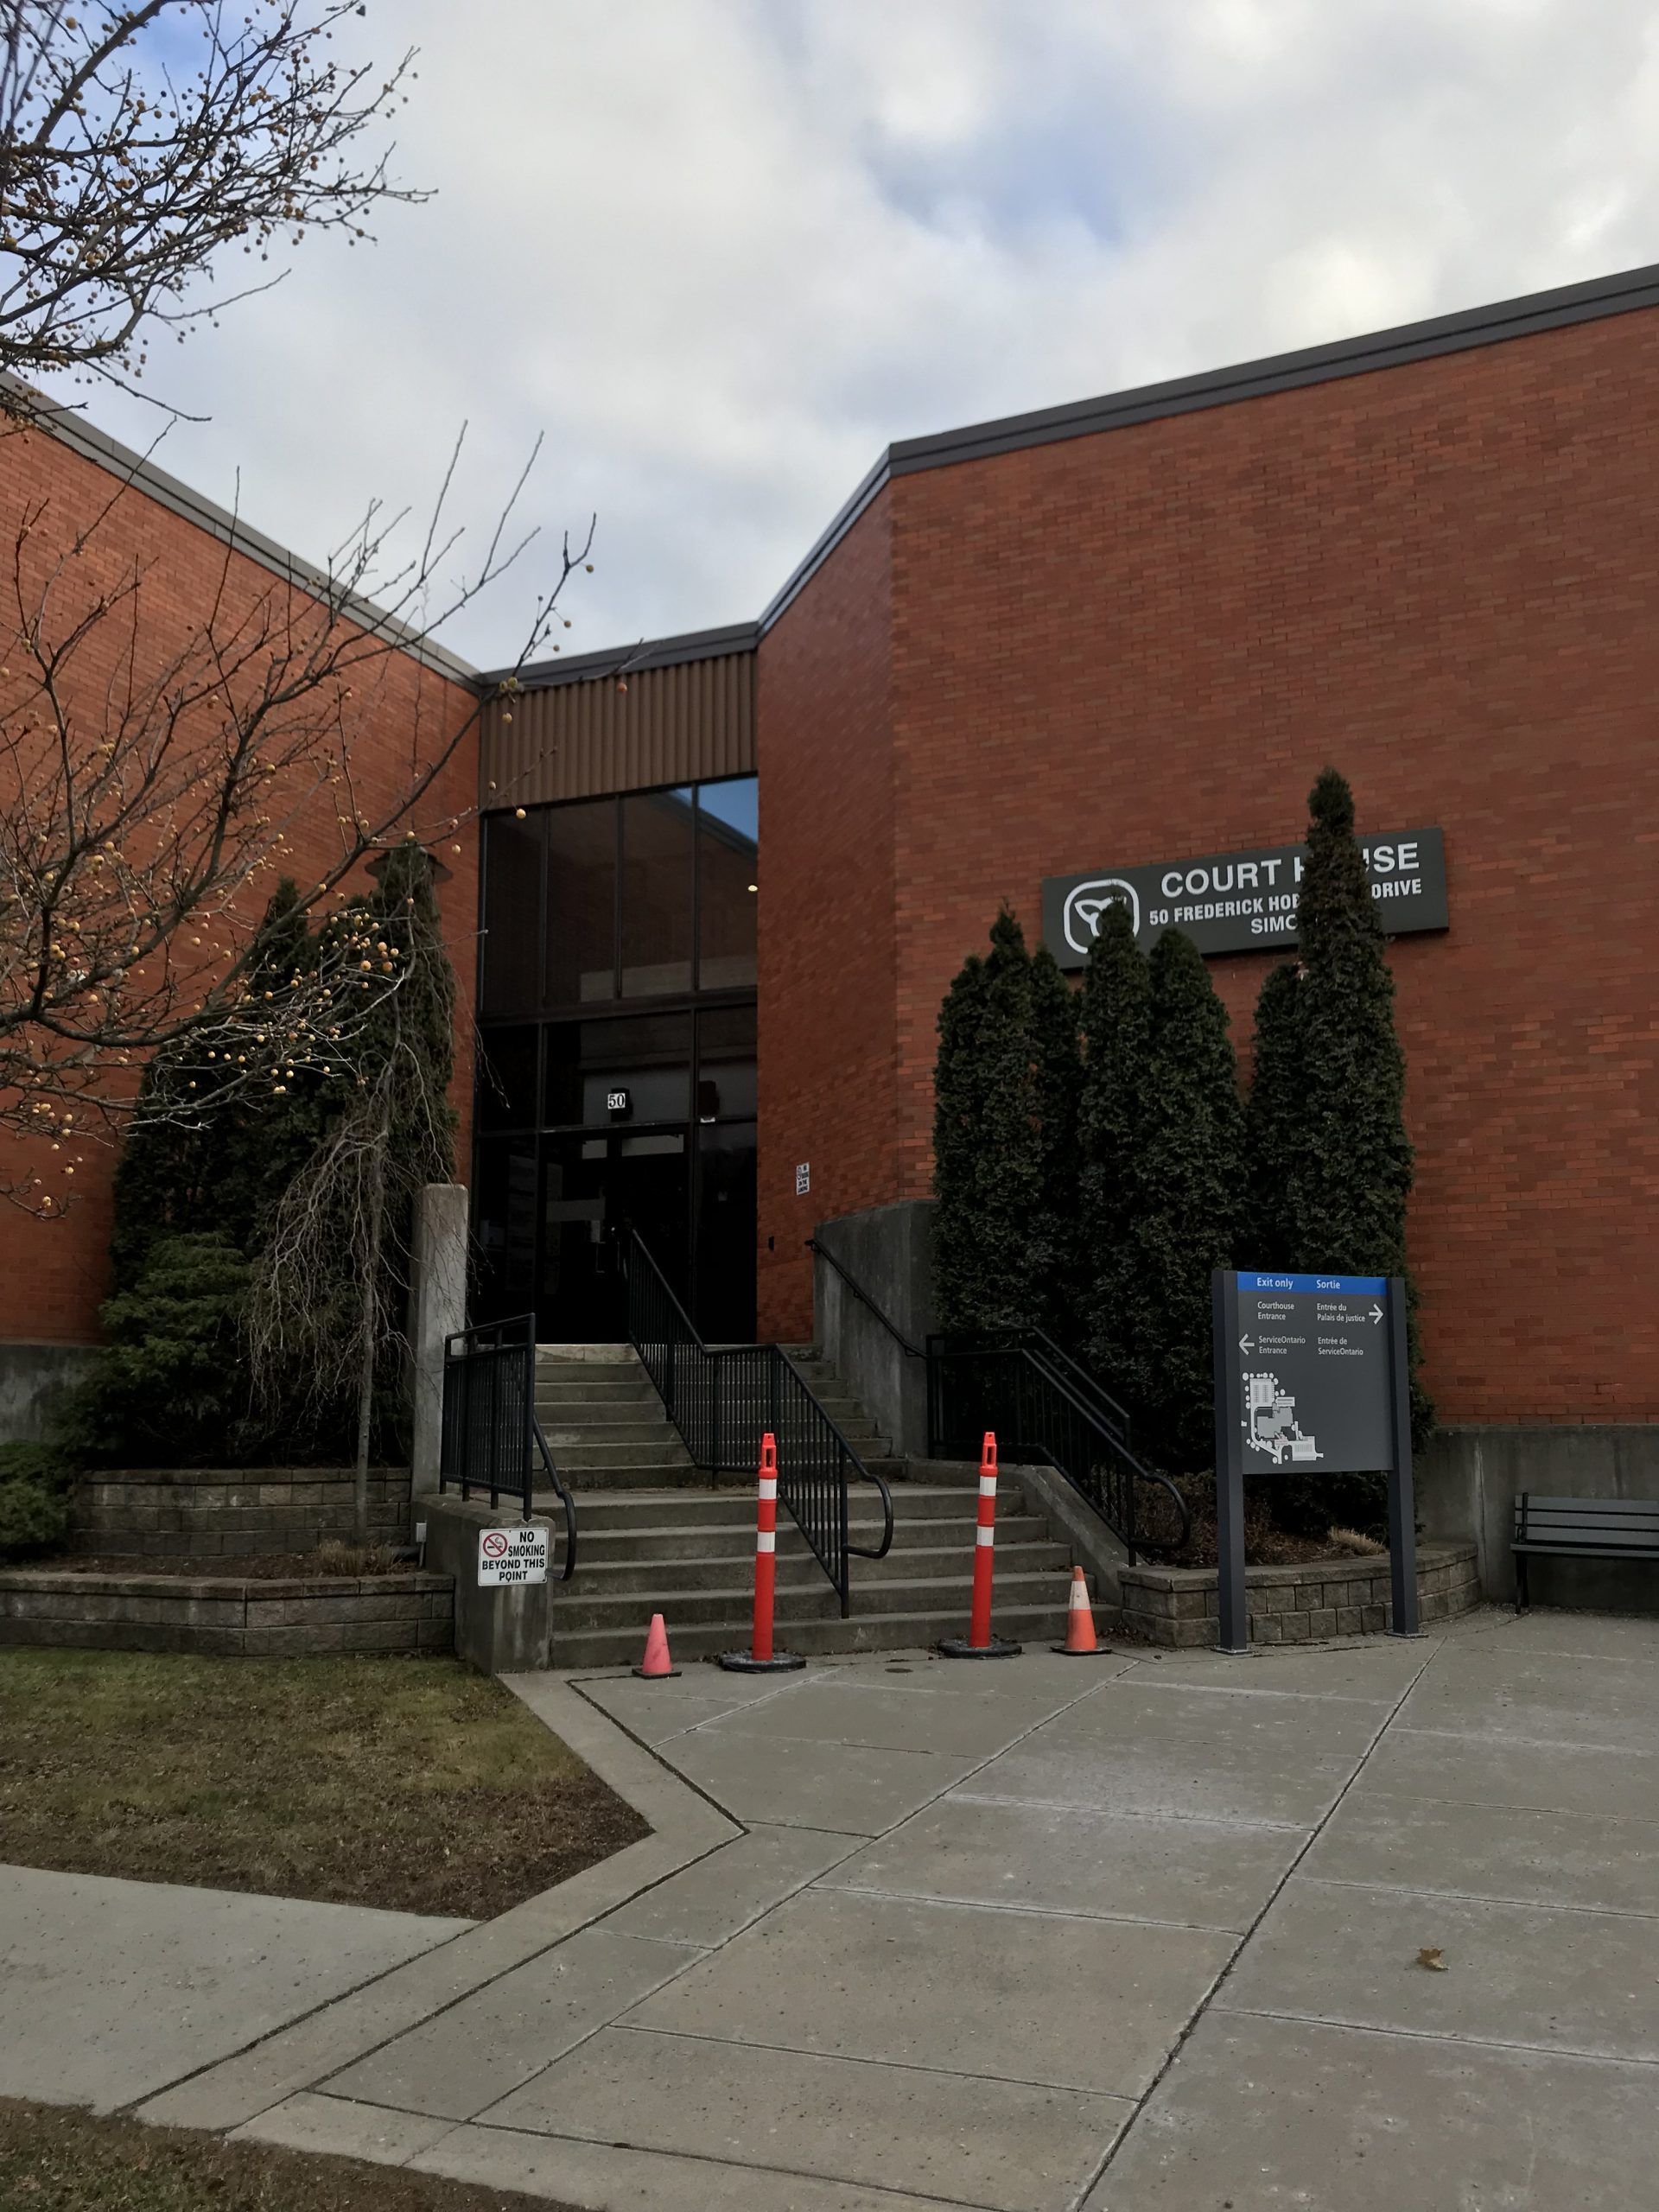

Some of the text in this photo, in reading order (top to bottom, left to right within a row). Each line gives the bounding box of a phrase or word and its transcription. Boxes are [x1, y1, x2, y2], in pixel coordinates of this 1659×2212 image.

[1161, 858, 1282, 899] COURT
[1149, 909, 1169, 925] 50
[1173, 898, 1264, 923] FREDERICK
[1371, 878, 1422, 899] DRIVE
[1250, 914, 1298, 935] SIMC
[609, 1094, 625, 1108] 50
[1256, 1277, 1294, 1290] Exit only
[1316, 1279, 1341, 1289] Sortie
[1257, 1300, 1295, 1310] Courthouse
[1317, 1302, 1347, 1312] Entrée du
[1257, 1312, 1287, 1320] Entrance
[1317, 1313, 1336, 1322] Palais
[1344, 1314, 1366, 1324] justice
[1258, 1335, 1306, 1344] ServiceOntario
[1338, 1337, 1348, 1345] de
[1259, 1346, 1287, 1355] Entrance
[1318, 1347, 1363, 1356] ServiceOntario
[519, 1531, 535, 1543] NO
[508, 1544, 545, 1557] SMOKING
[482, 1558, 545, 1570] BEYOND THIS
[499, 1571, 528, 1581] POINT
